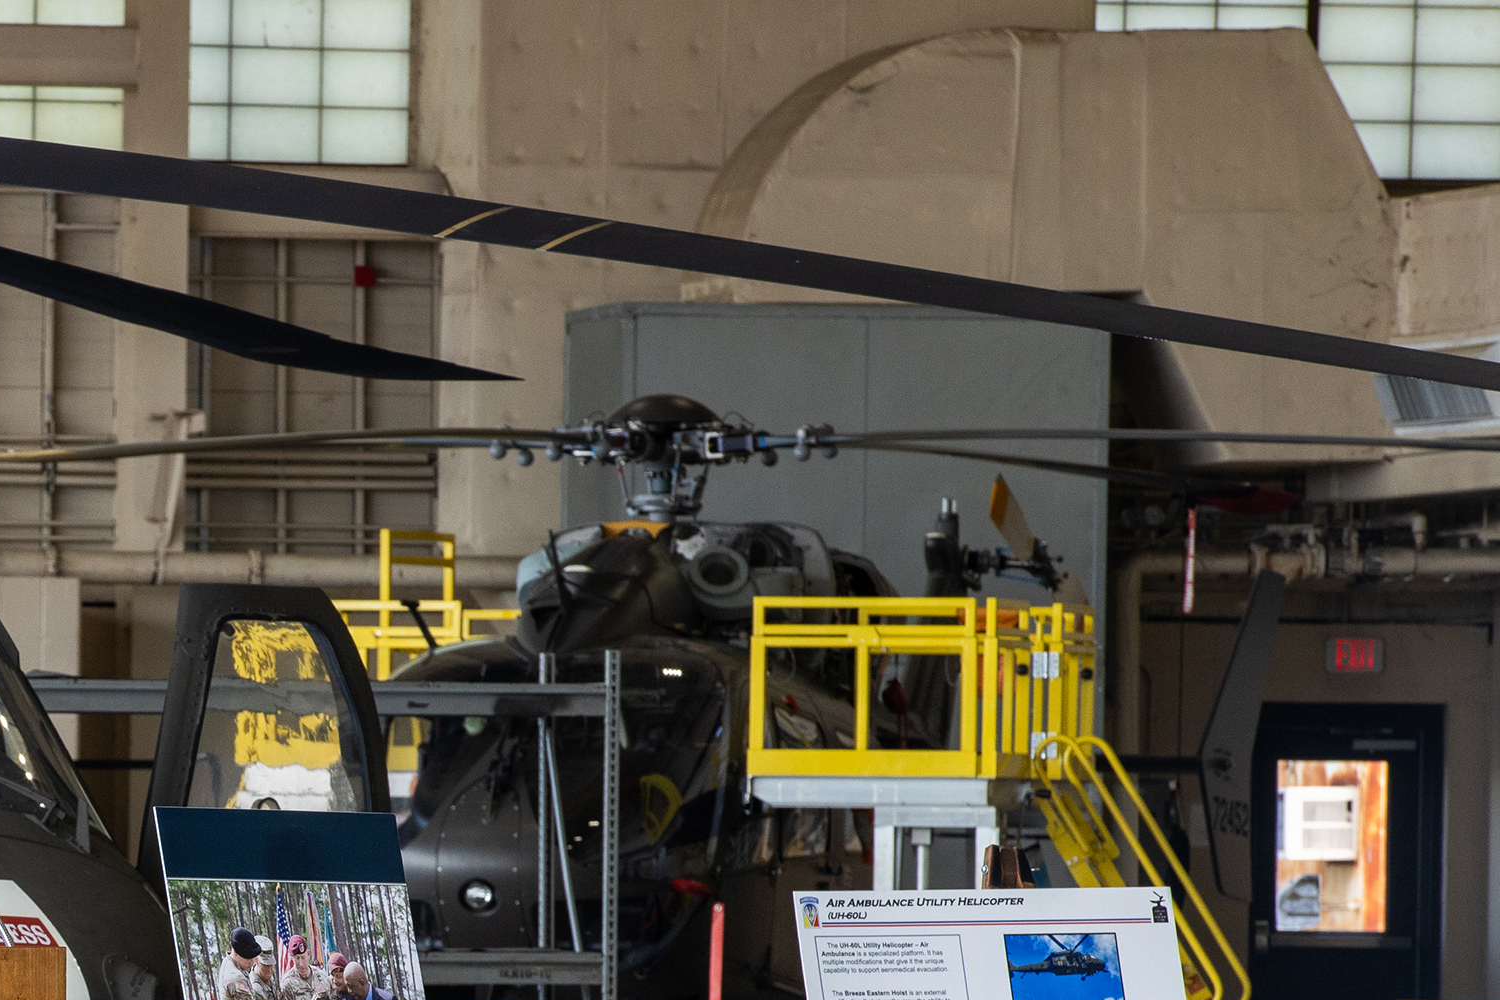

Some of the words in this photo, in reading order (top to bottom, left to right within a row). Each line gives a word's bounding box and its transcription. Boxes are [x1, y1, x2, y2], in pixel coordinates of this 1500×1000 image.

[1335, 638, 1377, 672] EXIT
[826, 898, 845, 908] AIR
[847, 898, 914, 907] AMBULANCE
[916, 897, 956, 906] UTILITY
[957, 897, 1024, 906] HELICOPTER
[827, 911, 868, 920] (UH-60L)
